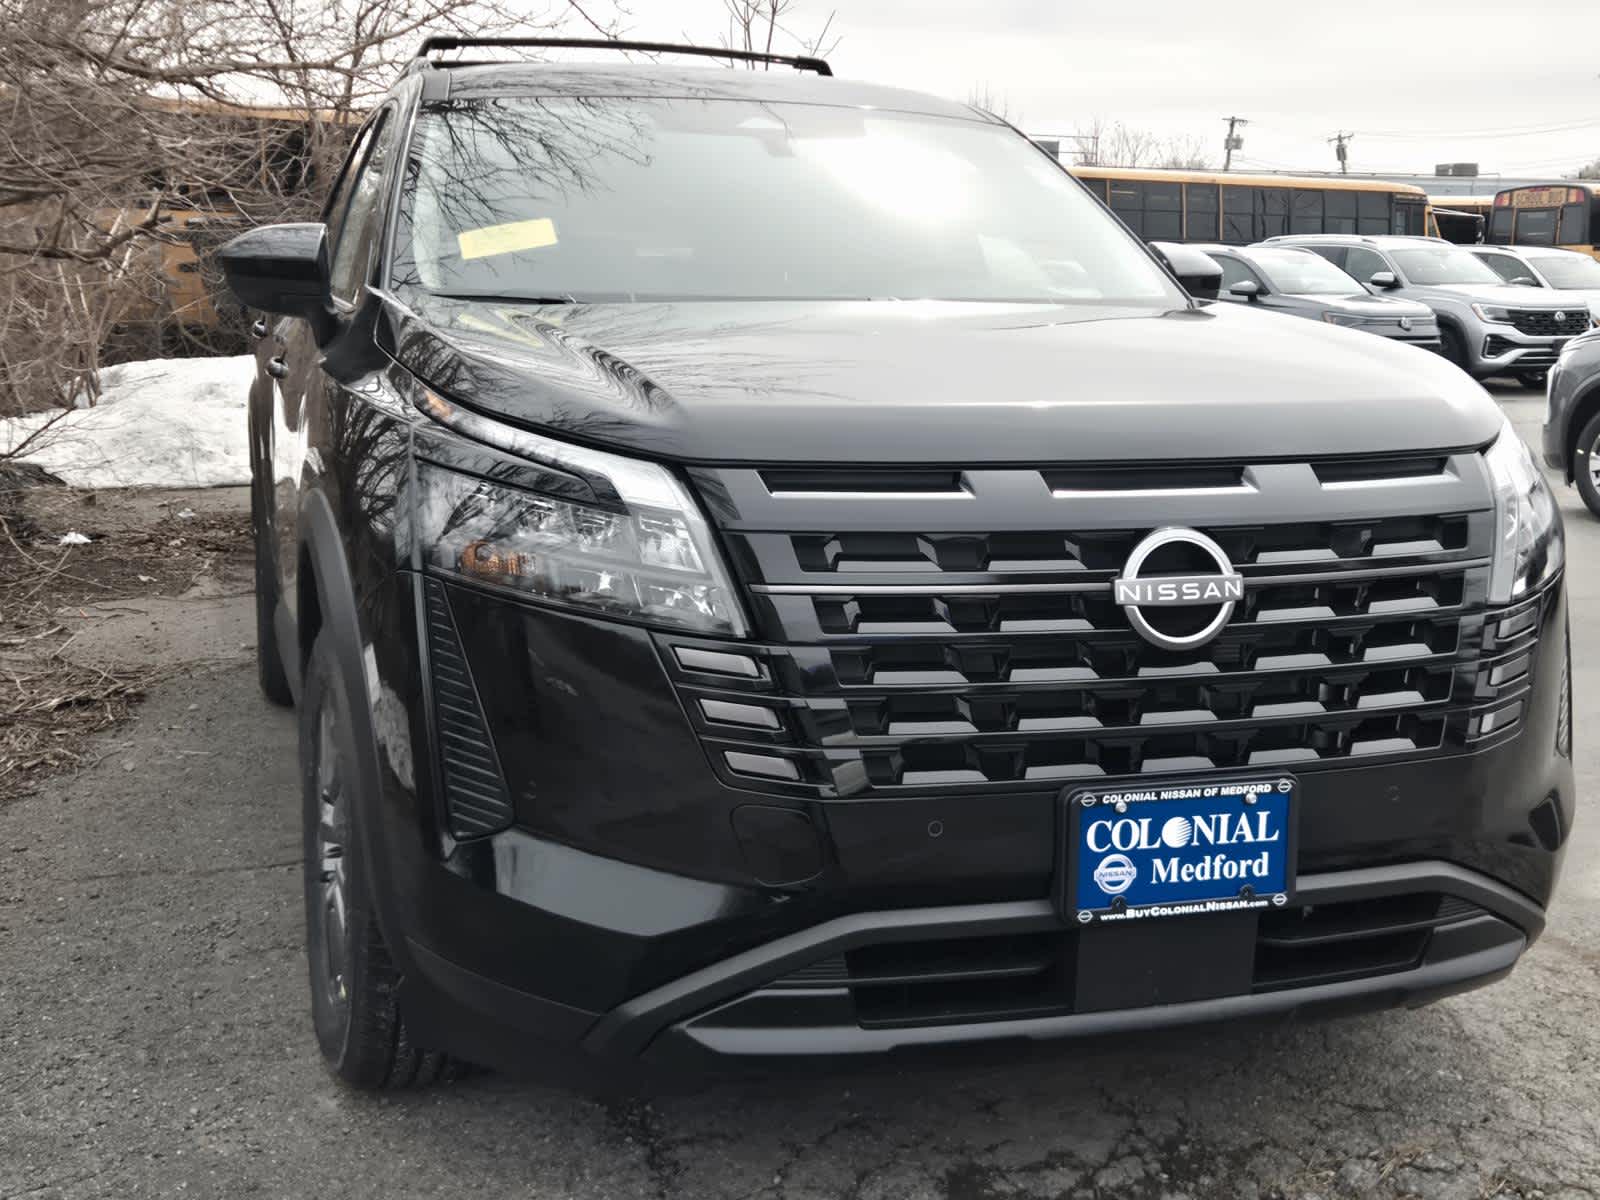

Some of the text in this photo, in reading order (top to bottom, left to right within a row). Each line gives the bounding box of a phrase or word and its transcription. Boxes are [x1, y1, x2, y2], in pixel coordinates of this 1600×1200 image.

[1119, 580, 1241, 601] NISSAN
[1103, 791, 1158, 804] COLONIAL
[1160, 788, 1201, 800] NISSAN
[1203, 788, 1218, 797] OF
[1221, 784, 1272, 795] MEDFORD
[1086, 811, 1280, 853] COLONIAL
[1099, 870, 1132, 878] NISSAN
[1150, 851, 1269, 884] Medford
